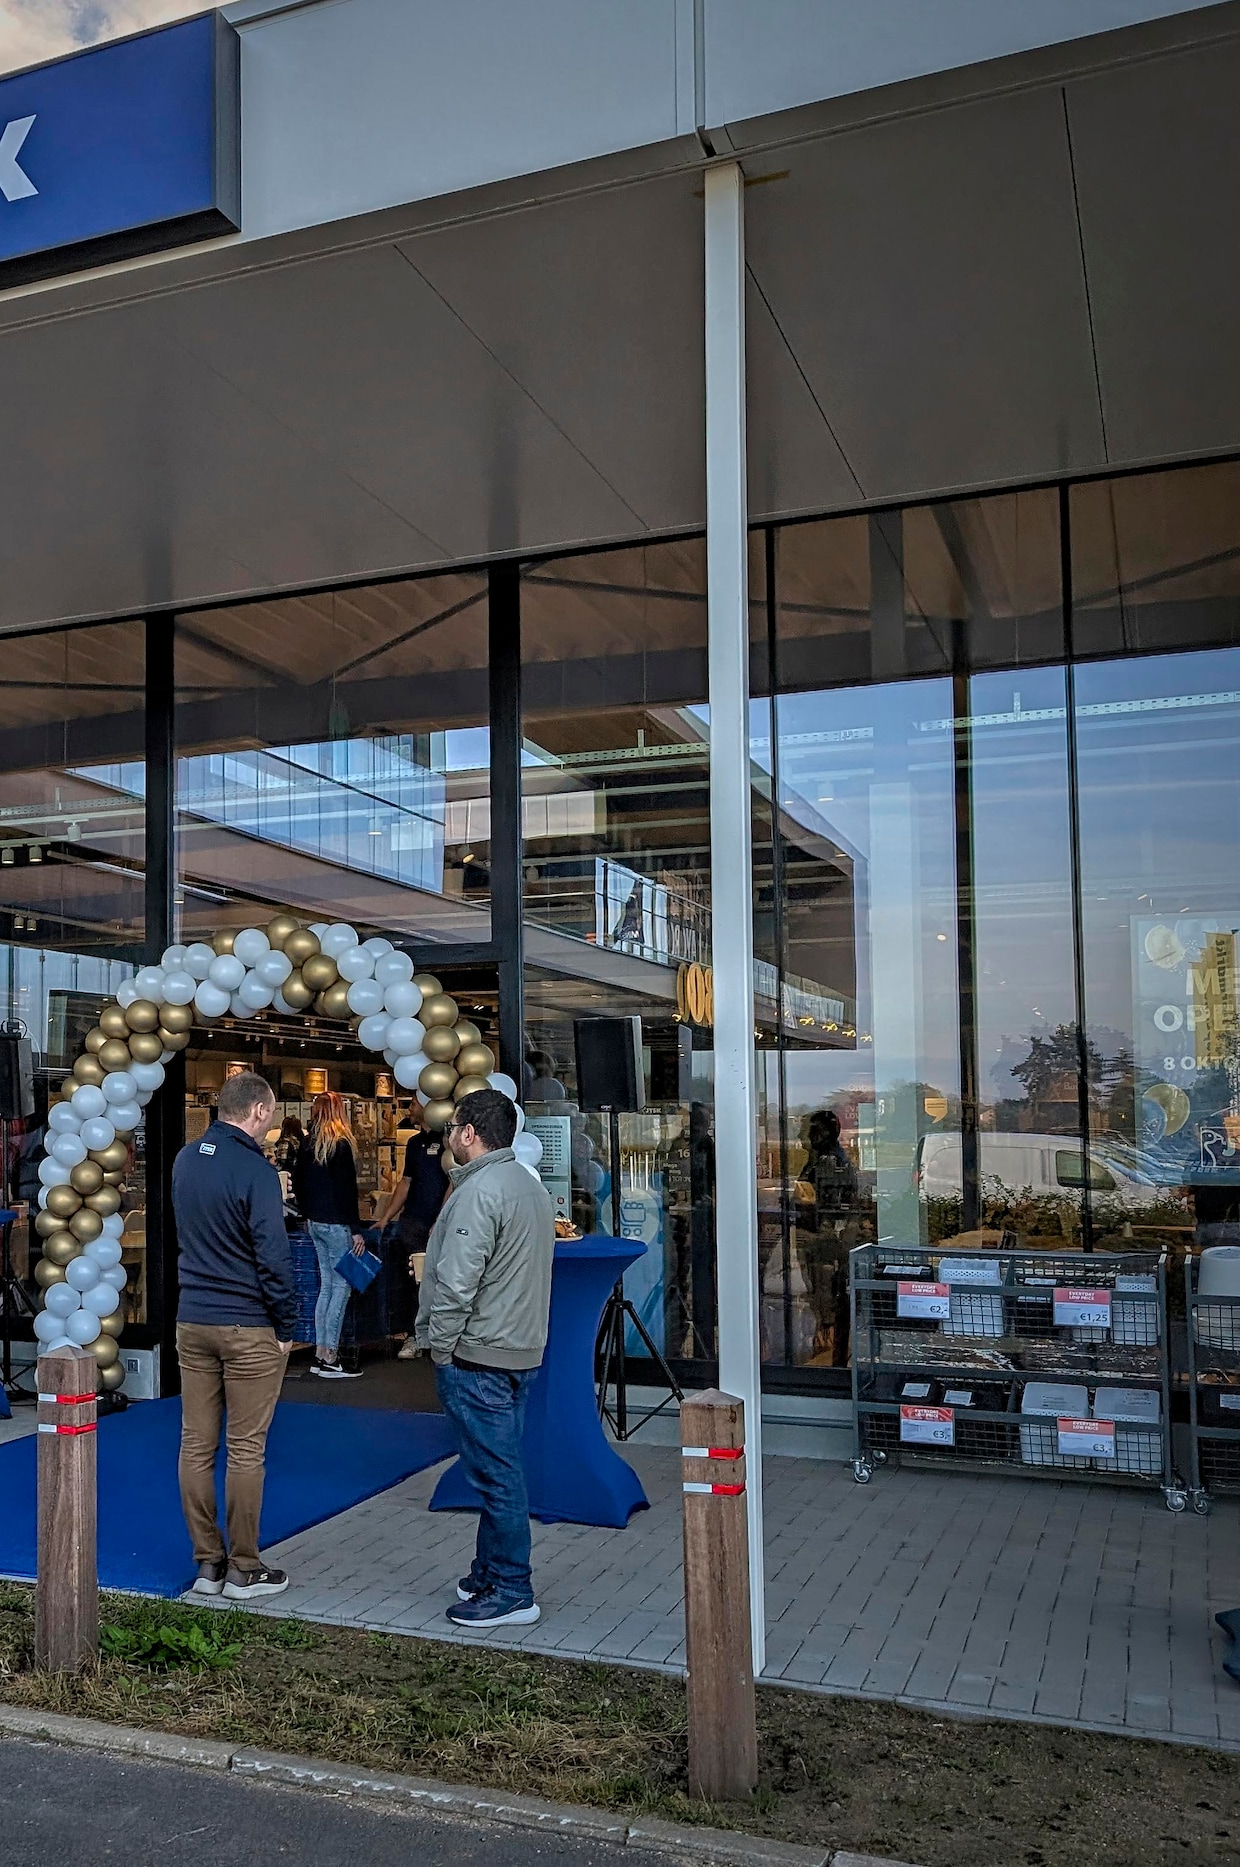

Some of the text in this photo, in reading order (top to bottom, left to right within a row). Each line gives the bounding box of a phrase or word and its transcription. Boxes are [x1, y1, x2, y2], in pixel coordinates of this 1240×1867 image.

[1163, 1056, 1176, 1071] 8
[930, 1305, 948, 1315] €2,-
[1080, 1313, 1108, 1323] €1,25
